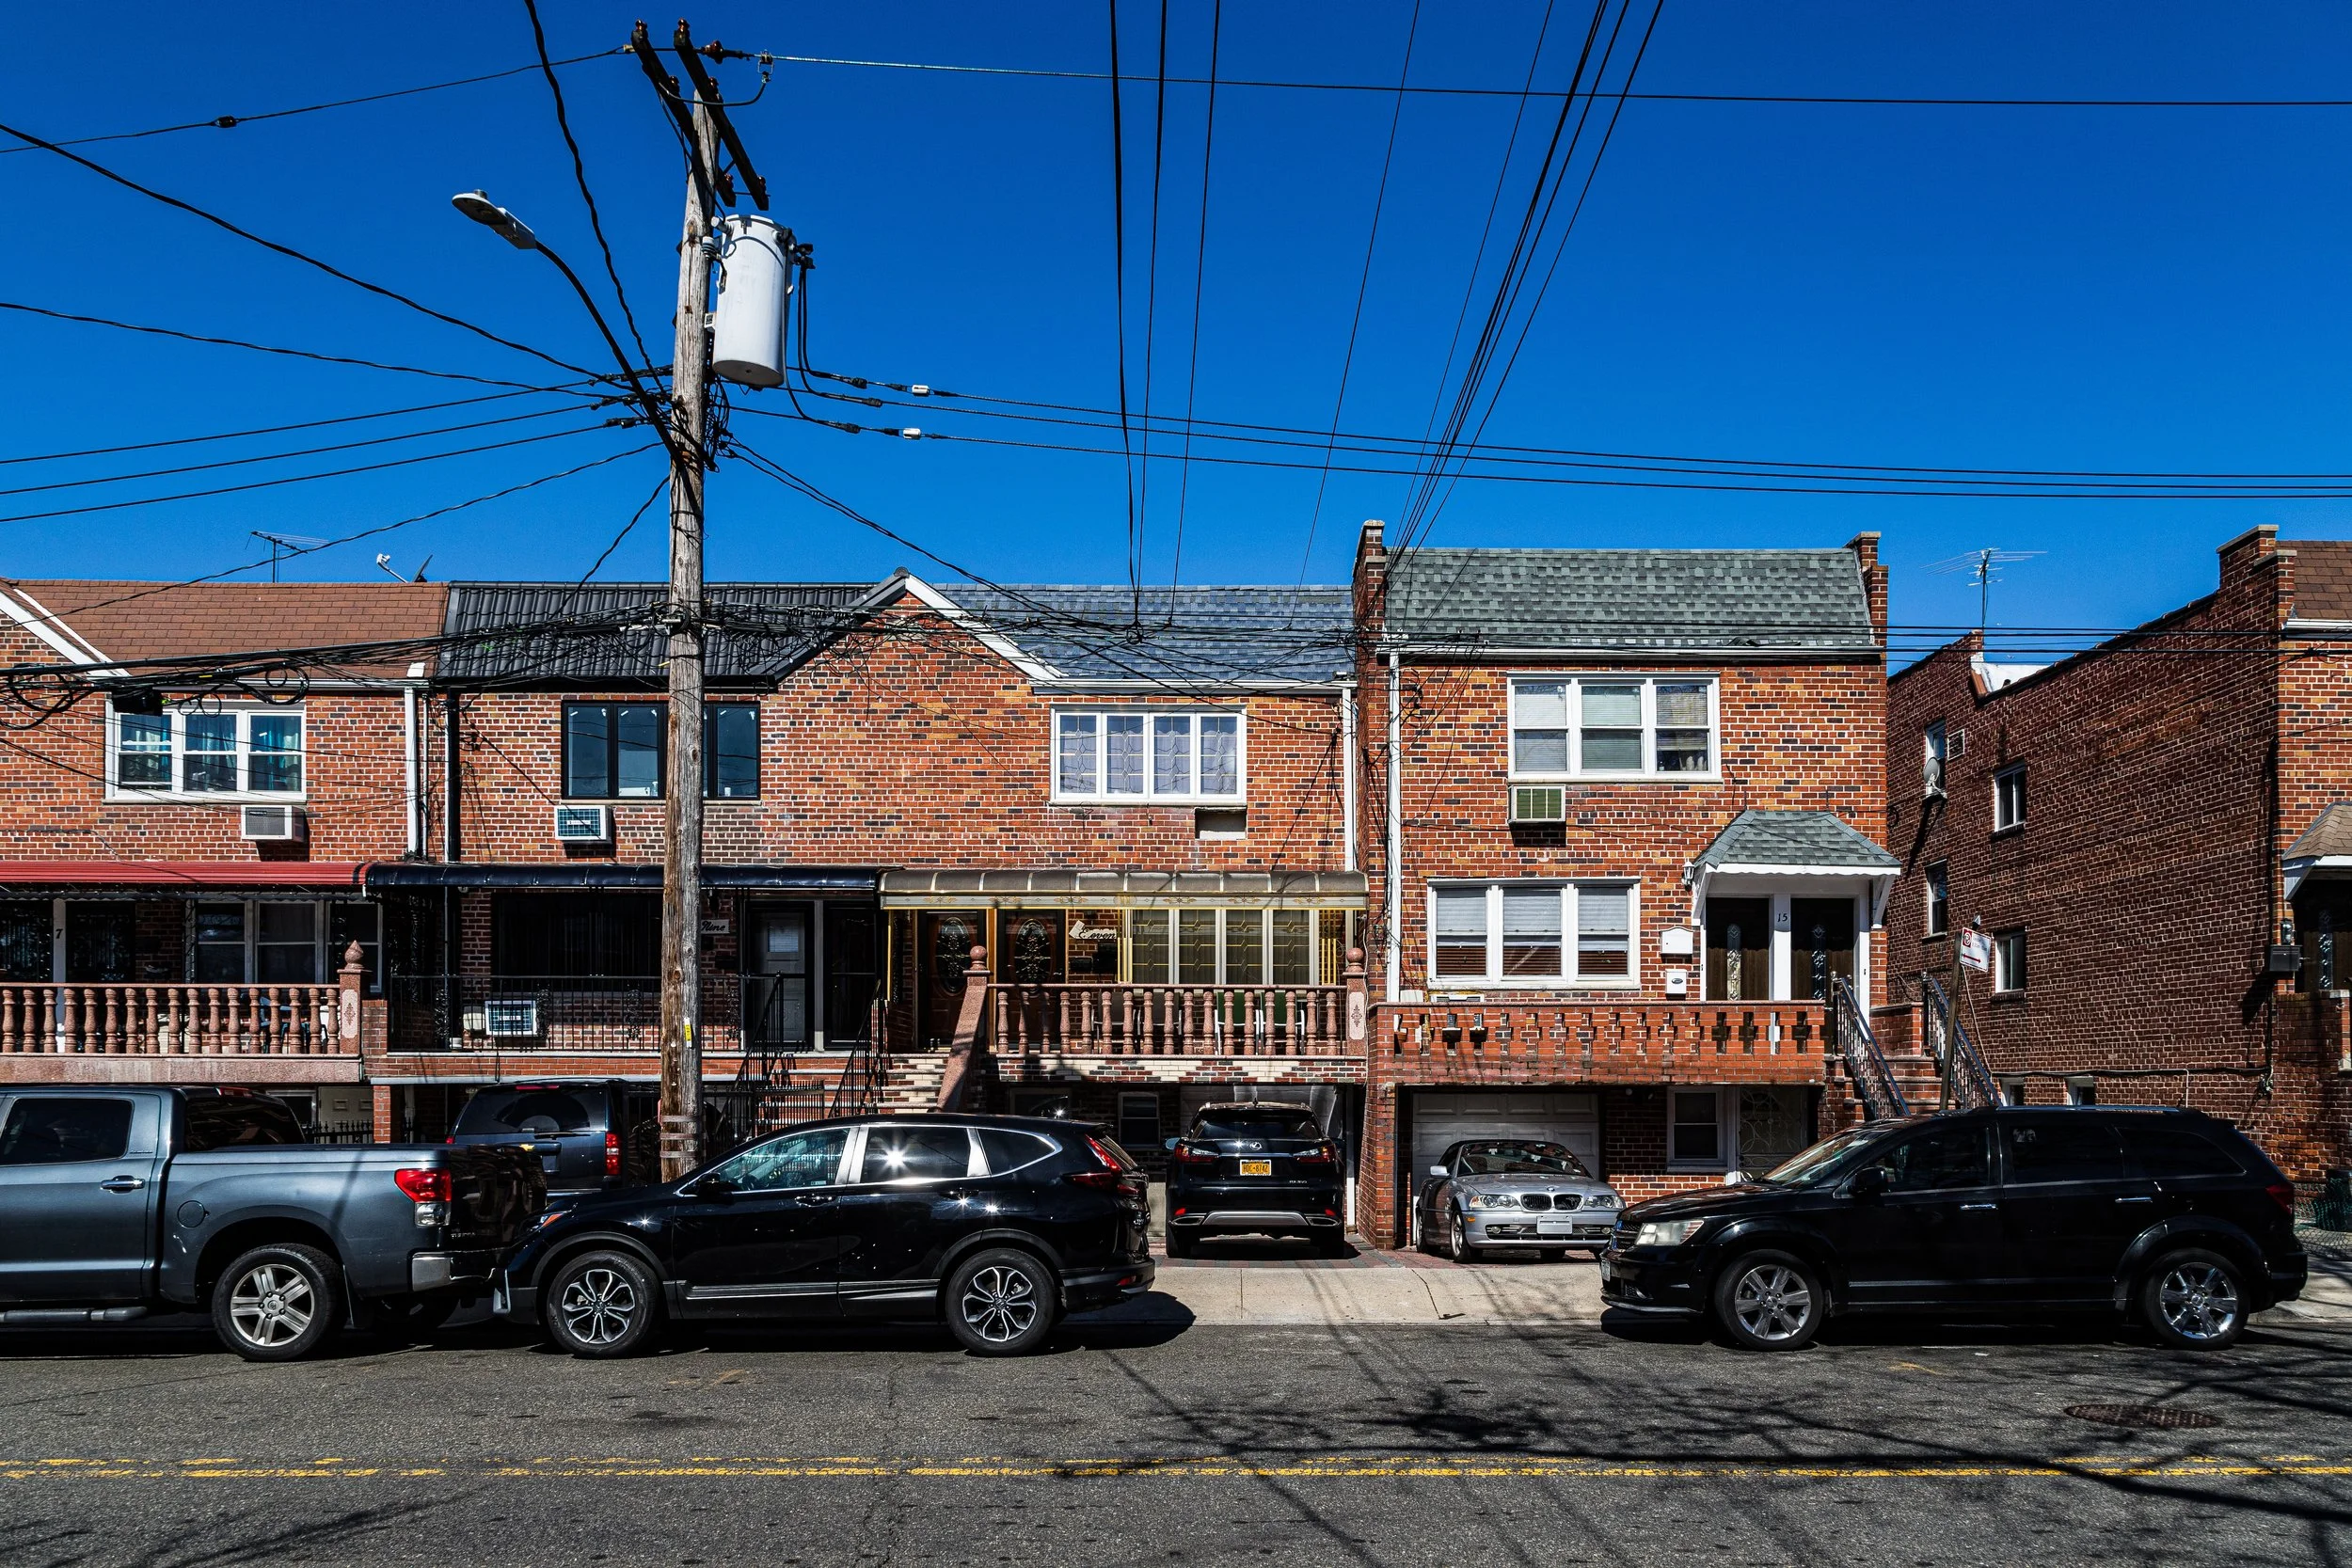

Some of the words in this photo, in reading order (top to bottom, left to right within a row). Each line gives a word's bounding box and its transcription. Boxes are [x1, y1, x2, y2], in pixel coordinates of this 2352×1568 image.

[1777, 912, 1788, 923] 15
[700, 920, 726, 932] Nine
[56, 927, 64, 940] 7
